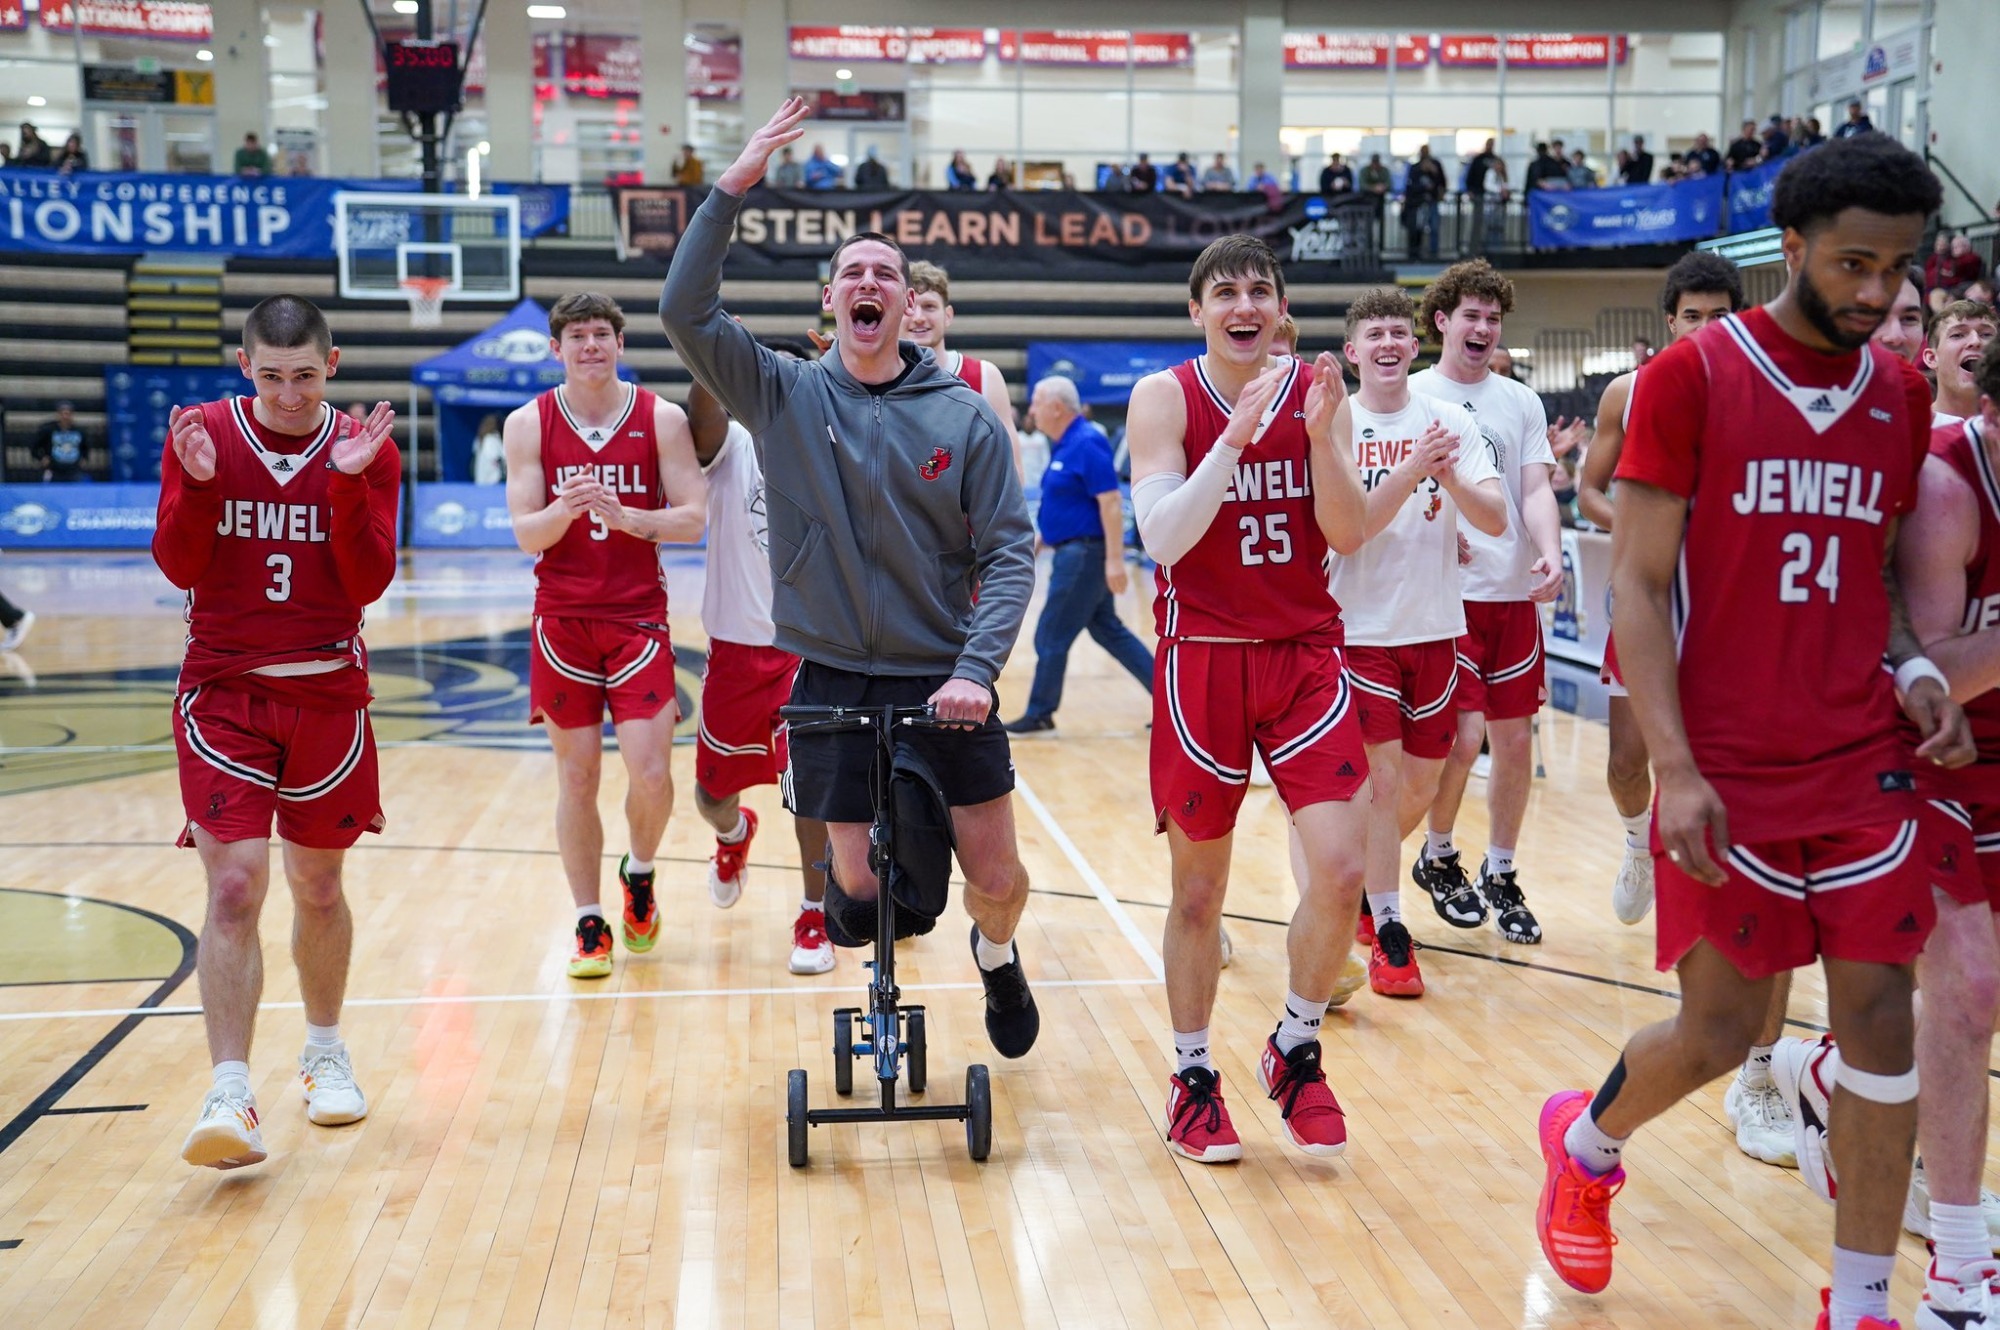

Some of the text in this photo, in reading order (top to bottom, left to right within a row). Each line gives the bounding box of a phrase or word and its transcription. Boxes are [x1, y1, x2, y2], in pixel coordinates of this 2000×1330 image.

[1532, 43, 1605, 60] CHAMPION
[97, 182, 287, 205] CONFERENCE
[9, 198, 291, 246] IONSHIP
[870, 210, 1020, 246] LEARN
[1034, 211, 1152, 247] LEAD
[1357, 439, 1418, 468] JEWE
[1732, 459, 1883, 525] JEWELL
[217, 500, 333, 542] JEWEL
[1239, 513, 1293, 566] 25
[265, 553, 292, 602] 3
[1779, 532, 1840, 604] 24
